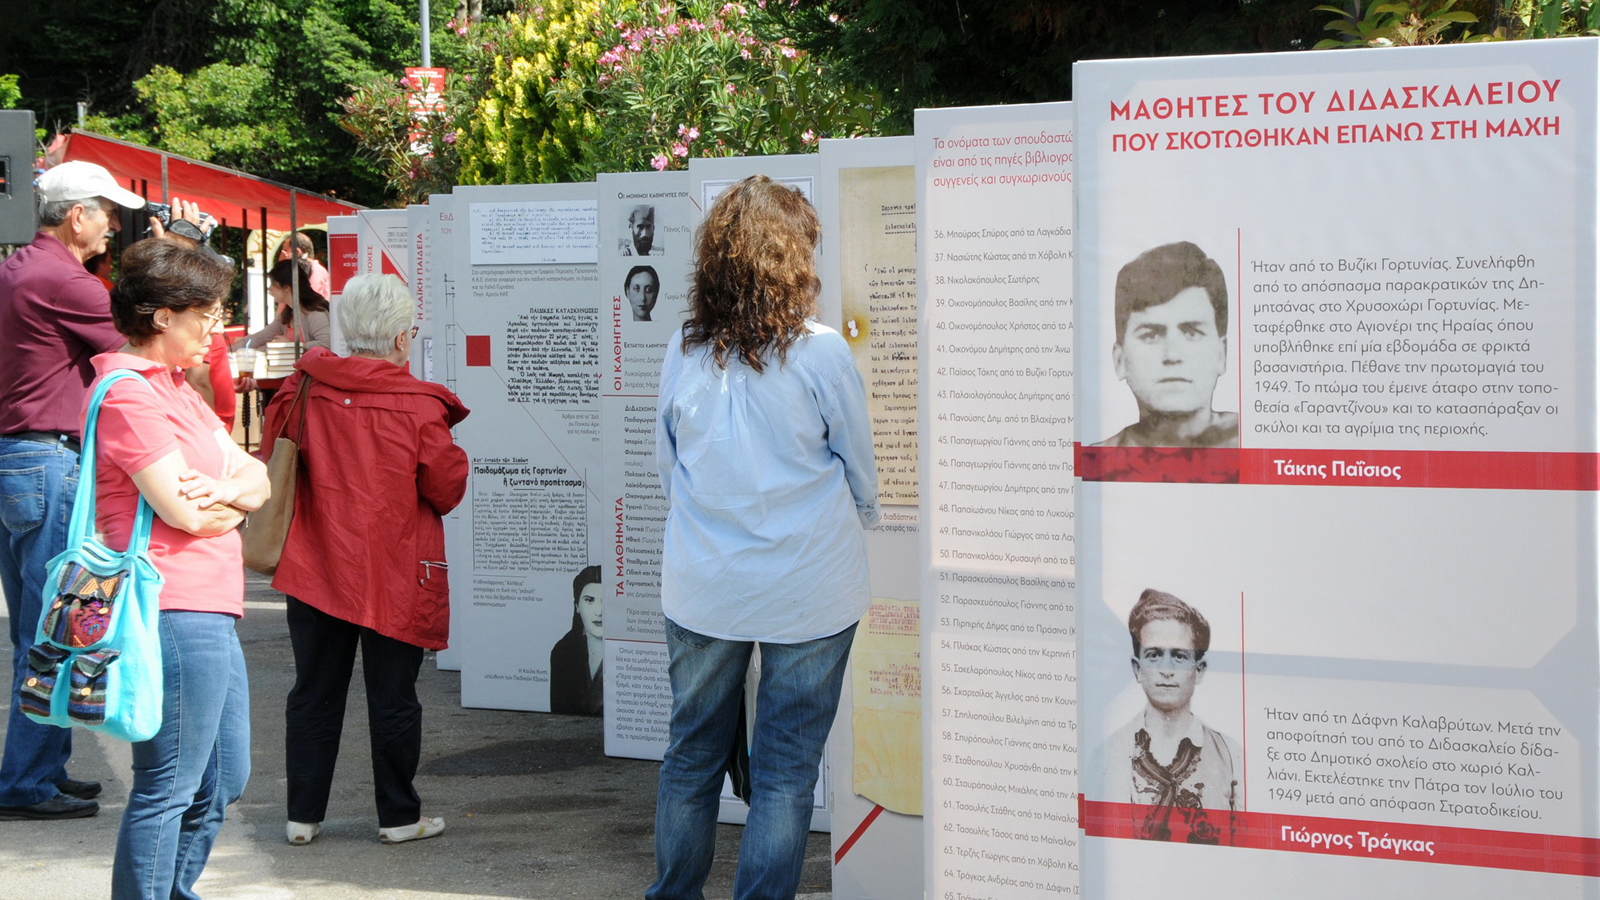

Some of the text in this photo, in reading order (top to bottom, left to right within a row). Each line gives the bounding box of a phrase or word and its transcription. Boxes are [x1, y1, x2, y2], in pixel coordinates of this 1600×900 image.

[1111, 80, 1560, 121] ΜΑΘΗΤΕΣ ΤΟΥ ΔΙΔΑΣΚΑΛΕΙΟΥ
[933, 138, 944, 149] Τα
[948, 136, 989, 150] ονόματα
[992, 138, 1011, 146] των
[1113, 116, 1559, 152] ΠΟΥ ΣΚΟΤΩΘΗΚΑΝ ΕΠΑΝΩ ΣΤΗ ΜΑΧΗ
[934, 156, 954, 168] είναι
[958, 154, 977, 167] από
[980, 157, 992, 167] τις
[995, 152, 1022, 168] πηγές
[934, 170, 1071, 189] συγγενείς και συγχωριανούς
[934, 230, 945, 239] 36.
[947, 230, 980, 240] Μπούρας
[982, 229, 1008, 239] Σπύρος
[1010, 228, 1025, 237] από
[1036, 226, 1071, 238] Λαγκάδια
[1251, 254, 1534, 274] Ήταν από το Βυζίκι Γορτυνίας. Συνελήφθη
[935, 275, 1040, 285] 38. Νικολακόπουλος Σωτήρης
[1254, 276, 1544, 294] από το απόσπασμα παρακρατικών της Δη-
[1254, 298, 1529, 316] μητσάνας στο Χρυσοχώρι Γορτυνίας. Με-
[1253, 318, 1533, 336] ταφέρθηκε στο Αγιονέρι της Ηραίας όπου
[613, 295, 622, 390] ΟΙ ΚΑΘΗΓΗΤΕΣ
[1254, 338, 1530, 356] υποβλήθηκε επί μία εβδομάδα σε φρικτά
[1254, 359, 1544, 376] βασανιστήρια. Πέθανε την πρωτομαγιά του
[1255, 380, 1558, 397] 1949. Το πτώμα του έμεινε άταφο στην τοπο-
[1254, 400, 1558, 418] θεσία «Γαραντζίνου» και το κατασπάραξαν οι
[1254, 420, 1488, 438] σκύλοι και τα αγρίμια της περιοχής.
[474, 466, 518, 476] Παιδομάζωμα
[1274, 460, 1326, 479] Τάκης
[615, 497, 624, 597] ΤΑ ΜΑΘΗΜΑΤΑ
[1264, 707, 1561, 736] Ήταν από τη Δάφνη Καλαβρύτων. Μετά την
[942, 731, 953, 740] 58.
[954, 732, 1003, 746] Σπυρόπουλος
[1004, 737, 1031, 750] Γιάννης
[1032, 742, 1047, 750] από
[1267, 730, 1559, 757] αποφοίτησή του από το Διδασκαλείο δίδα-
[1267, 746, 1540, 777] ξε στο Δημοτικό σχολείο στο χωριό Καλ-
[1267, 767, 1562, 800] λιάνι. Εκτελέστηκε την Πάτρα τον Ιούλιο του
[1269, 788, 1541, 819] 1949 μετά από απόφαση Στρατοδικείου.
[1282, 826, 1434, 856] Γιώργος Τράγκας
